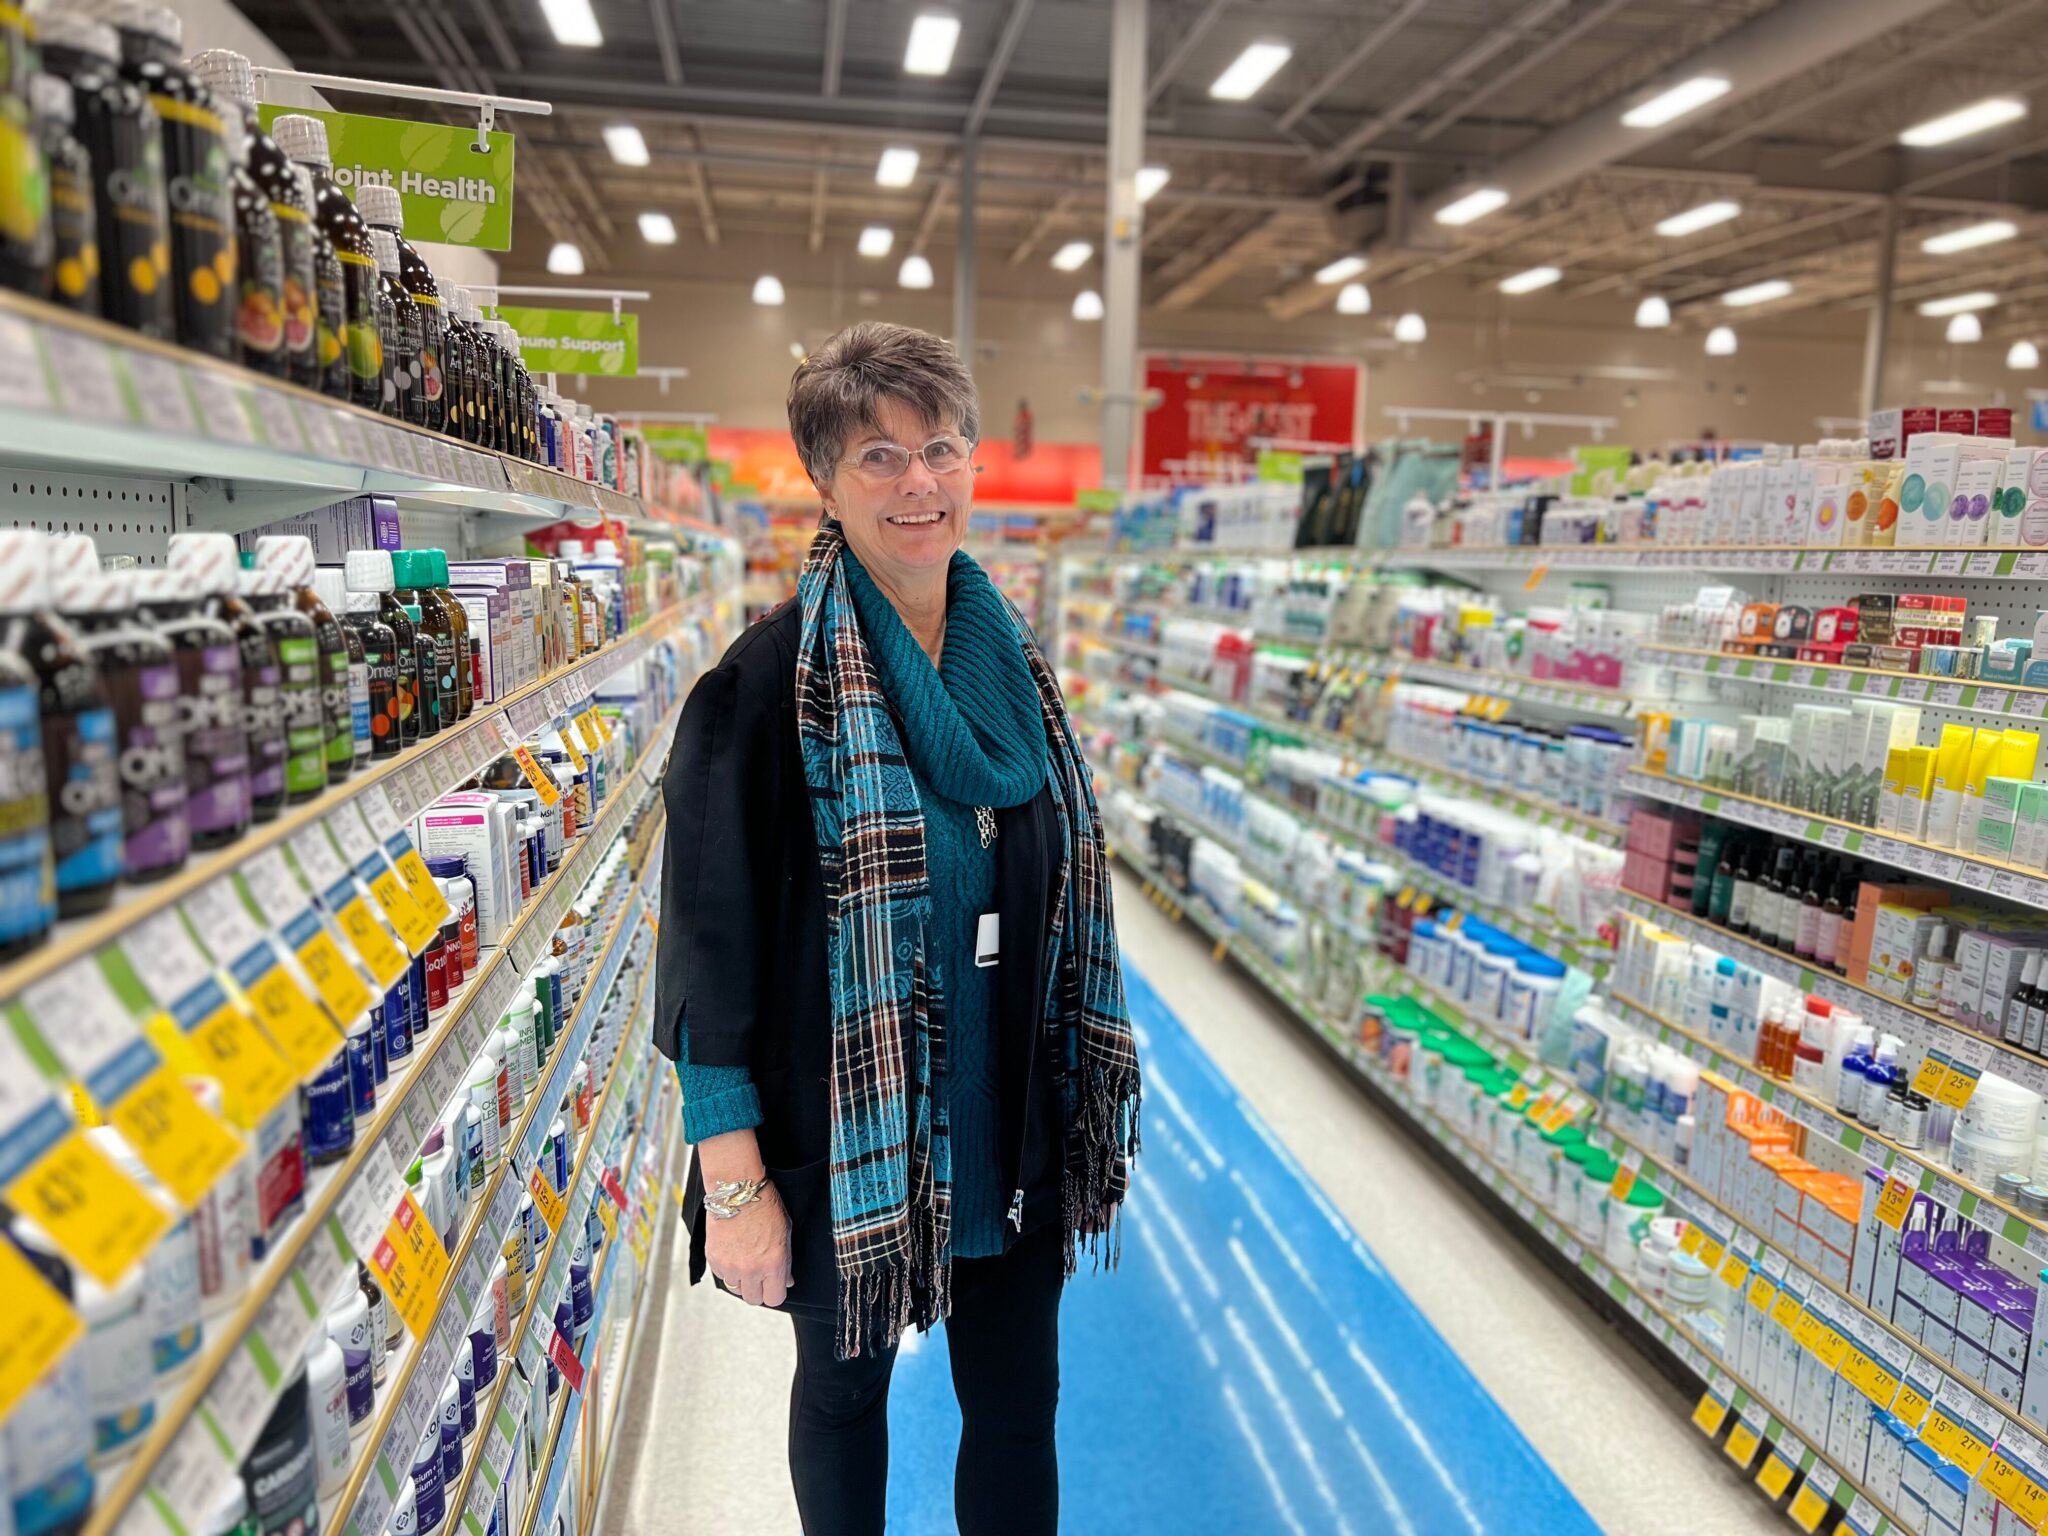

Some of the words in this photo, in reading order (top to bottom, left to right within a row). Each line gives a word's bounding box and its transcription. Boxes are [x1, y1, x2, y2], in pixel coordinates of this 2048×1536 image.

[401, 169, 496, 204] Health
[560, 335, 625, 354] Support
[426, 954, 447, 972] oQ10
